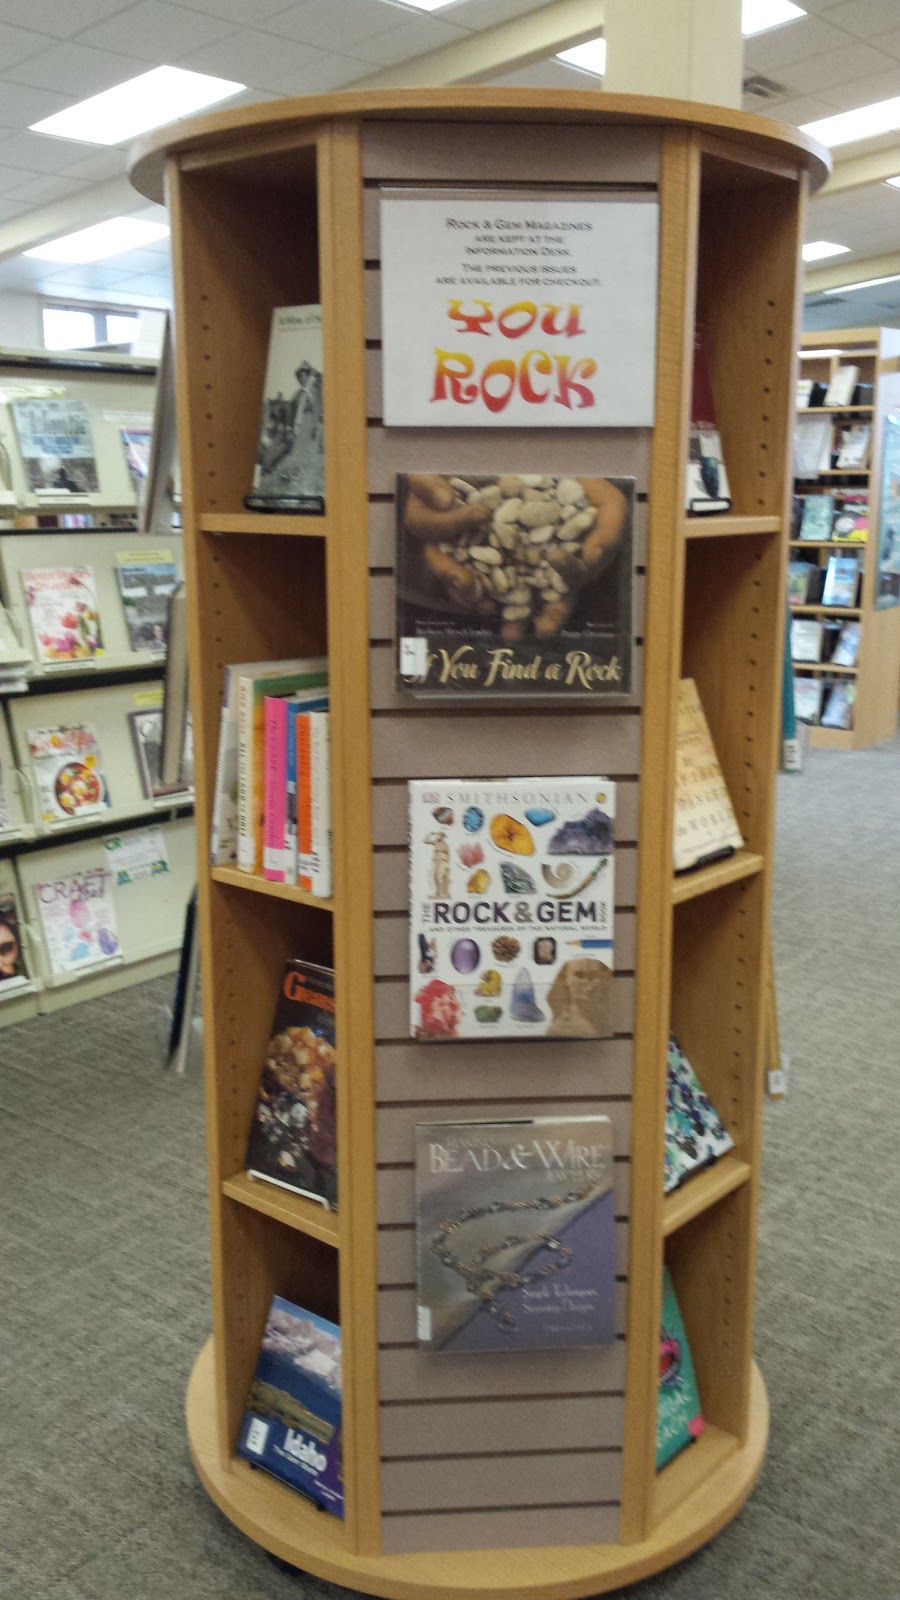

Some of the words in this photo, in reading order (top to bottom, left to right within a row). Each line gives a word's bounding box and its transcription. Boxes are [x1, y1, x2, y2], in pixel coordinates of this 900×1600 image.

[483, 219, 491, 230] &
[529, 235, 541, 244] AT
[543, 235, 565, 244] THE
[464, 246, 539, 256] INFORMATION
[461, 263, 483, 273] THE
[485, 264, 539, 274] PREVIOUS
[541, 265, 577, 275] ISSUES
[435, 277, 457, 286] ARE
[459, 277, 516, 286] AVAILABLE
[518, 277, 541, 287] FOR
[447, 299, 586, 339] YOU
[428, 346, 598, 413] ROCK
[438, 645, 480, 684] You
[484, 648, 543, 688] Find
[544, 662, 562, 680] a
[565, 650, 622, 690] Rock
[447, 792, 588, 804] SMITHSONIAN
[434, 902, 511, 923] ROCK
[514, 901, 533, 923] &
[537, 901, 597, 923] GEM
[283, 1428, 327, 1472] Idaho
